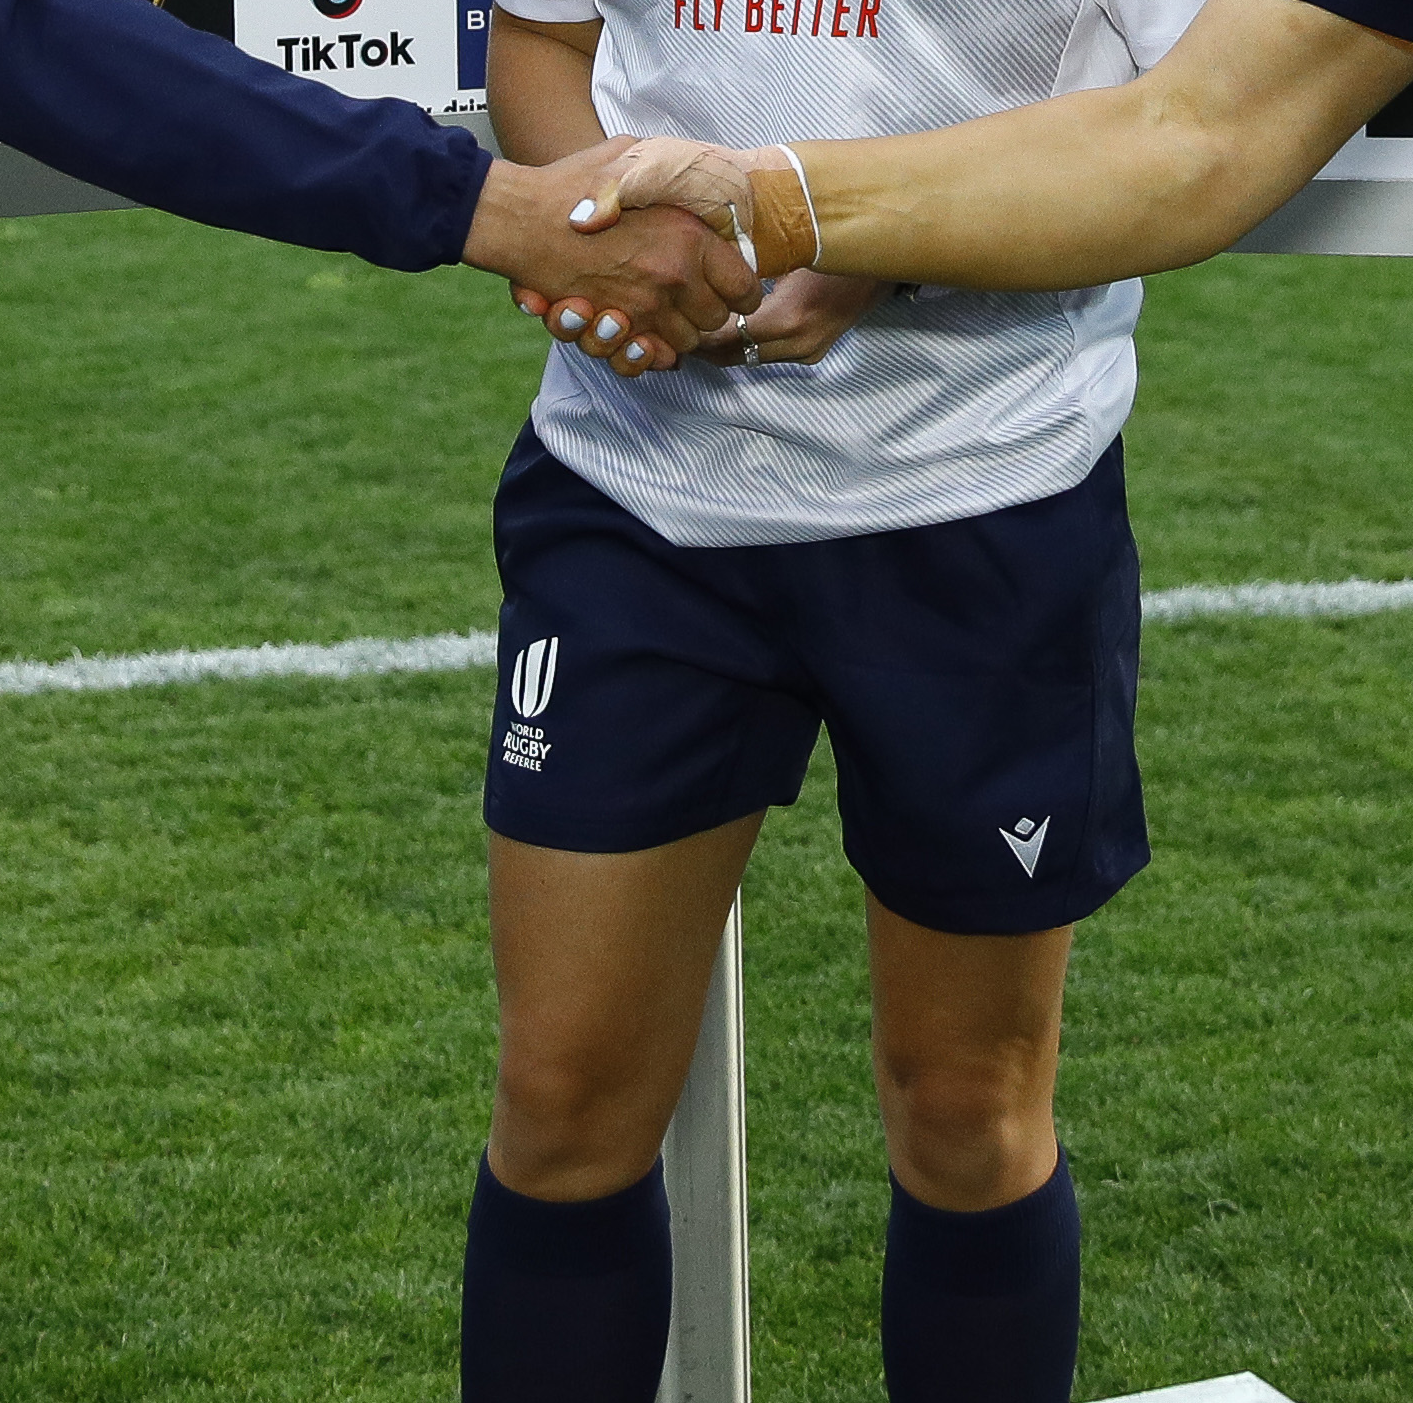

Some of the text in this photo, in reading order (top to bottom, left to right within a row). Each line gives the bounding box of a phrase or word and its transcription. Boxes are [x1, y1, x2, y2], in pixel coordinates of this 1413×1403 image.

[276, 32, 416, 72] TikTok
[503, 732, 551, 760] RUGBY
[503, 752, 542, 771] REFEREE
